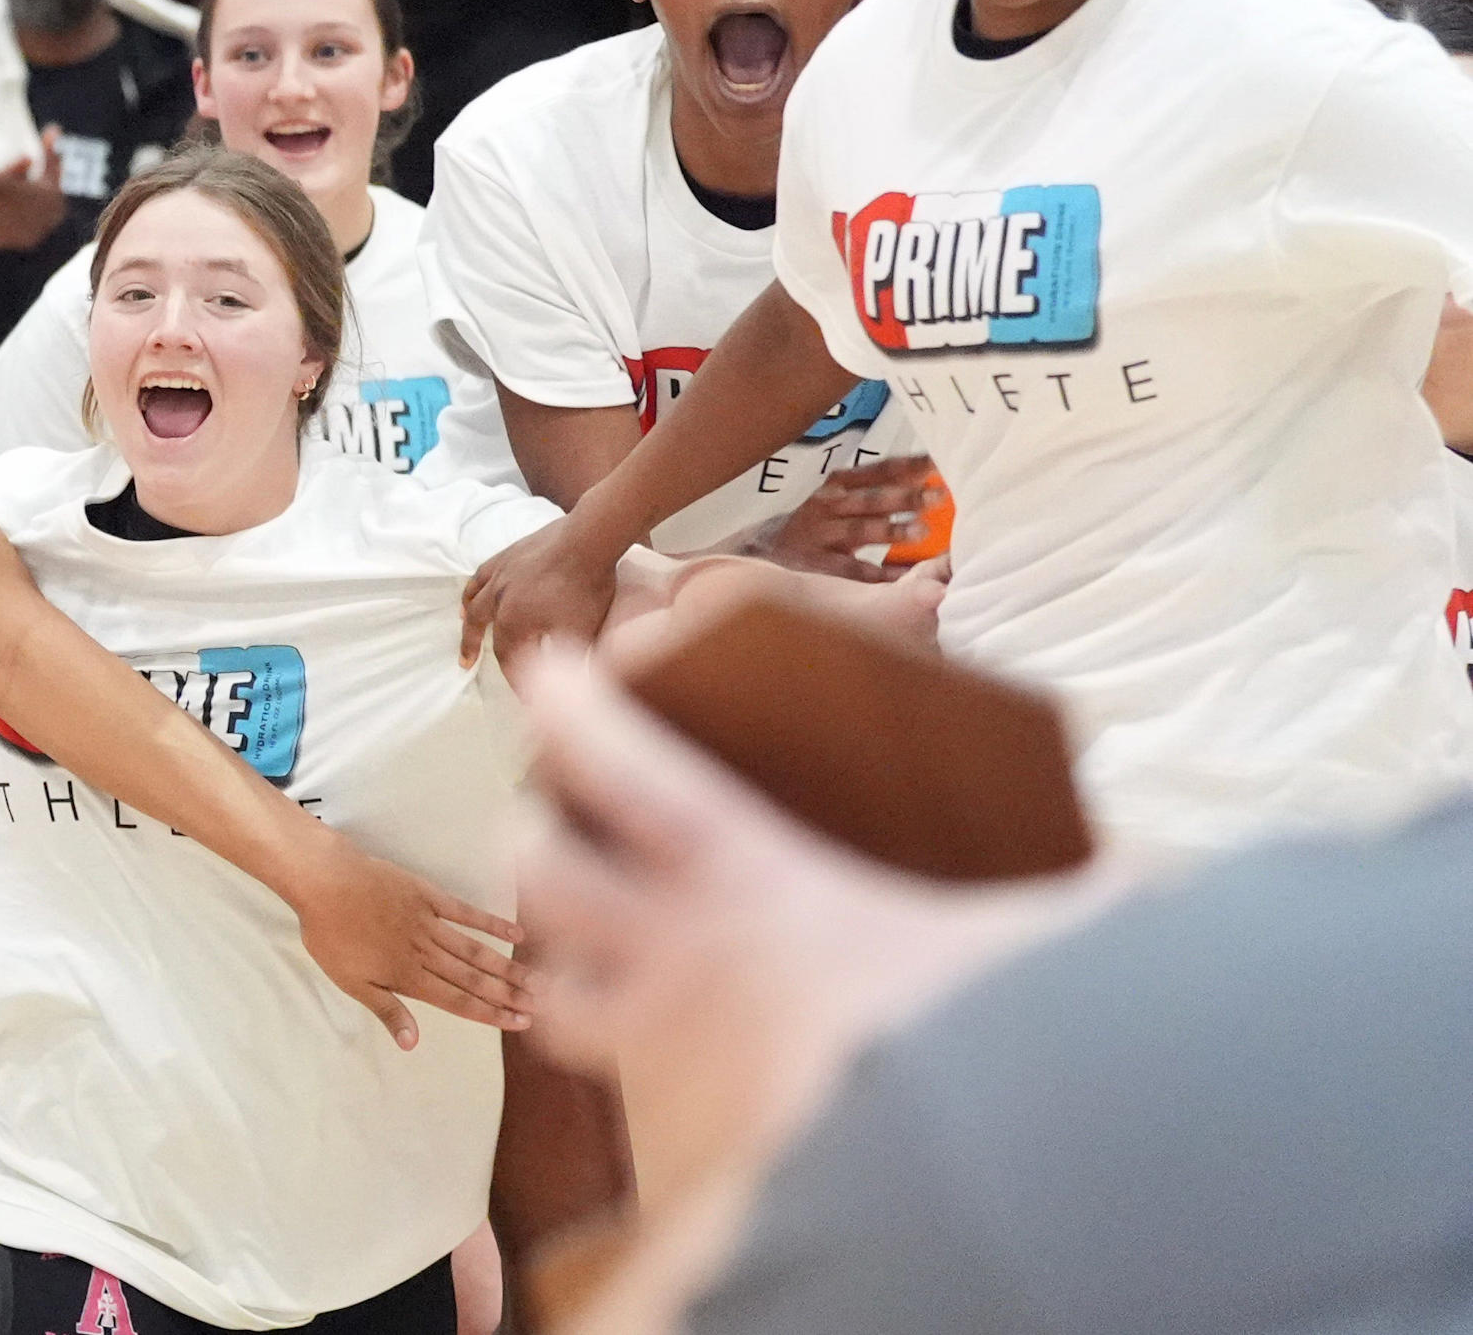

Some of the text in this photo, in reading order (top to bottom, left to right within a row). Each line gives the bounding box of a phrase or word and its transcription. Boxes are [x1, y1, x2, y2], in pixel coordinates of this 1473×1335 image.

[864, 212, 1045, 325] PRIME
[898, 360, 1157, 415] HLETE
[254, 694, 272, 760] HYDRATION
